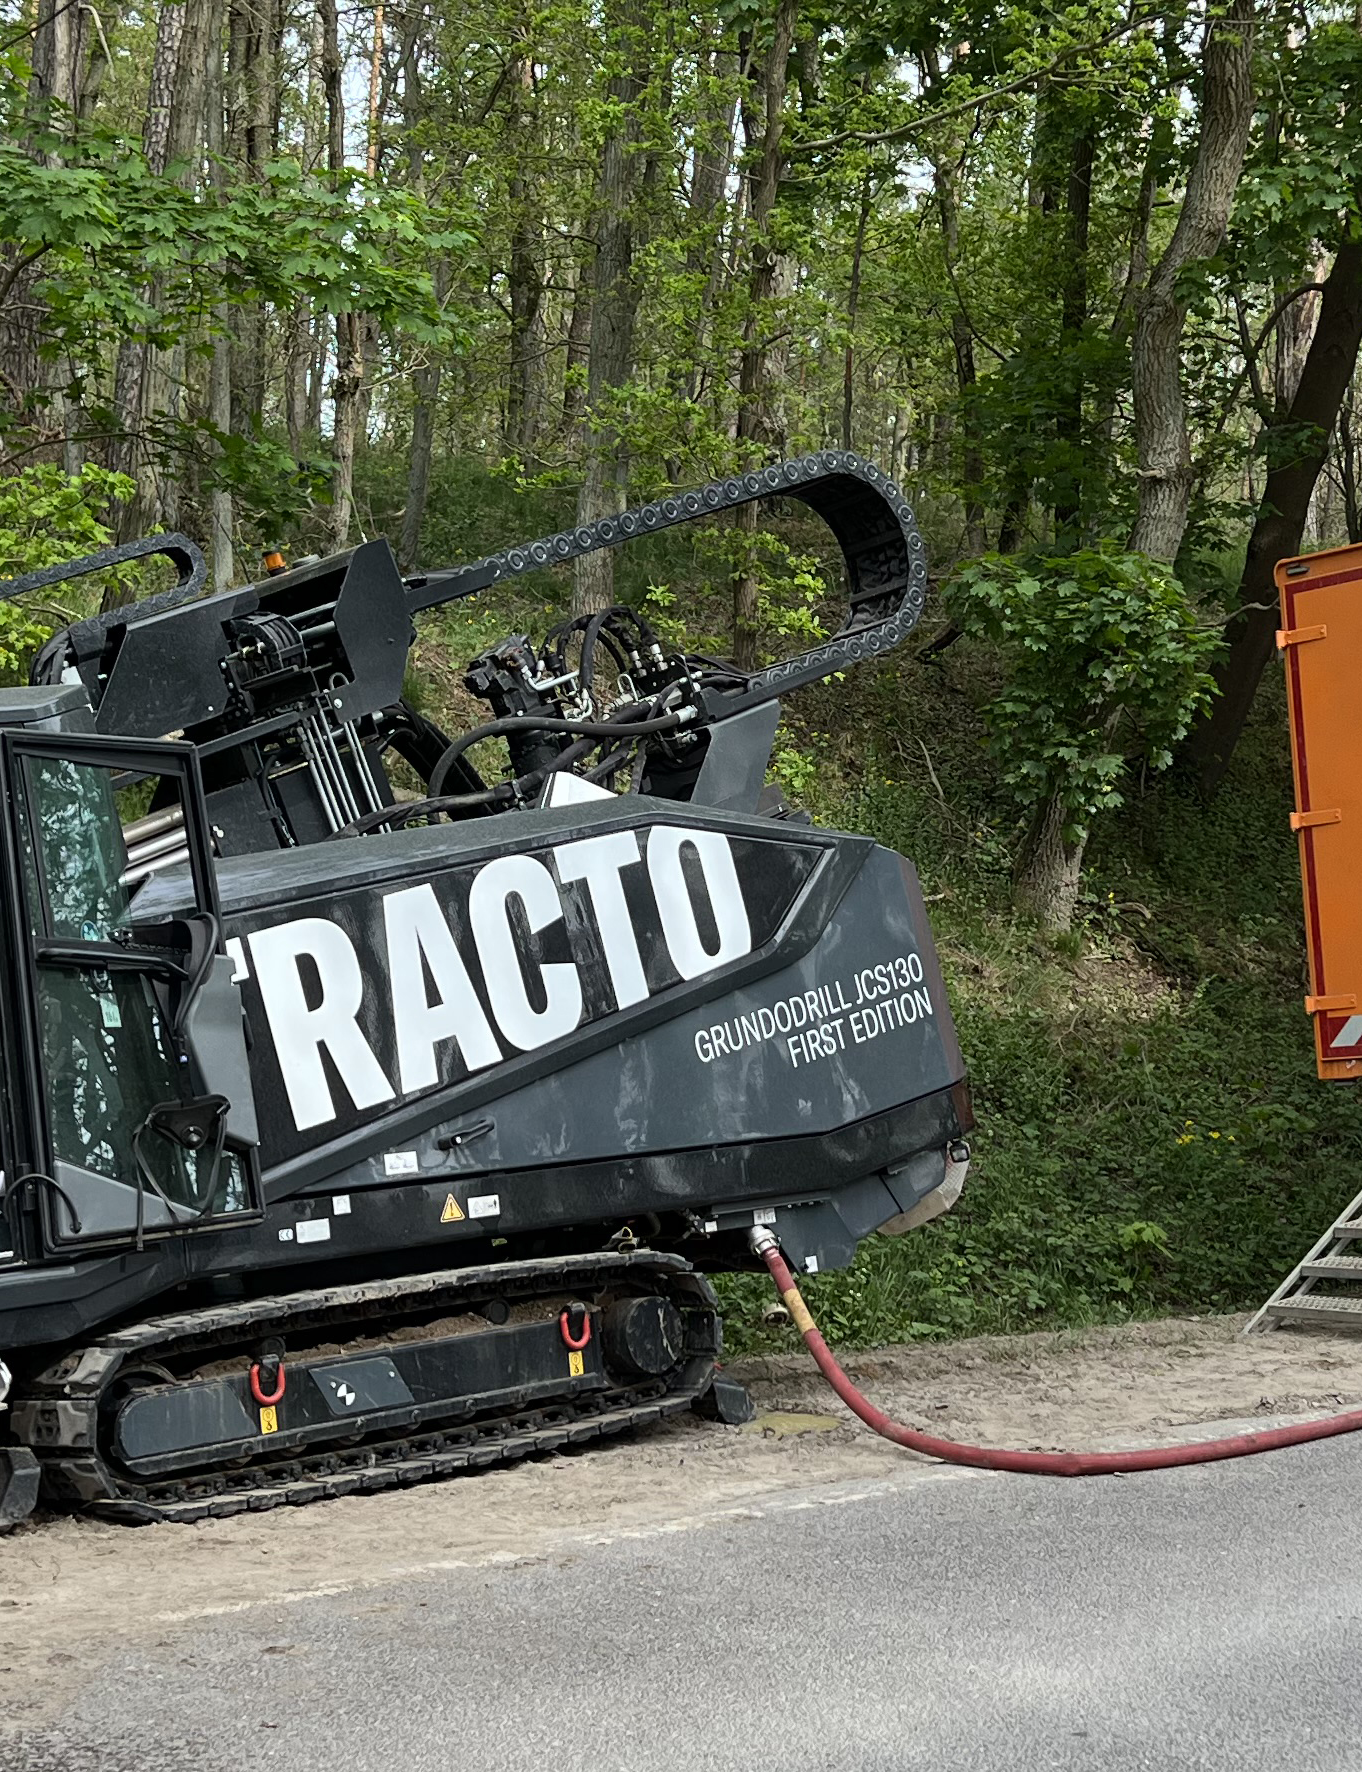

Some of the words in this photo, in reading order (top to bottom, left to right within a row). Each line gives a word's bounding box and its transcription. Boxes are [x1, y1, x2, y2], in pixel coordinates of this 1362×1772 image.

[226, 825, 752, 1132] RACTO
[694, 980, 852, 1064] GRUNDODRILL
[853, 952, 924, 1005] JCS130
[786, 1018, 846, 1068] FIRST
[849, 986, 933, 1043] EDITION
